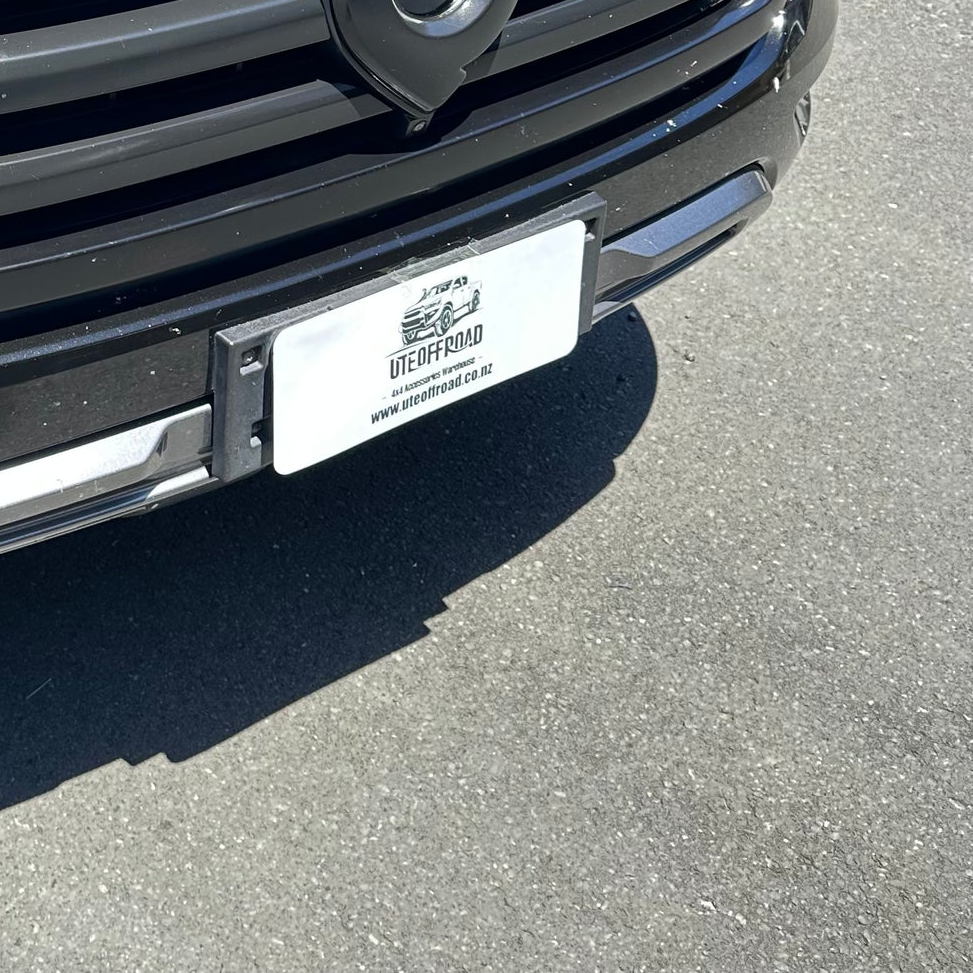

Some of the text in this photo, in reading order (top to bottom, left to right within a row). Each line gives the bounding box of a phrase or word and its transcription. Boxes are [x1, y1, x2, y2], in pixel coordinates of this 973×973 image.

[390, 324, 483, 379] UTEOFFROAD
[391, 357, 476, 398] 4x4 Accessories Warehouse
[371, 363, 493, 424] www.uteoffroad.co.nz
